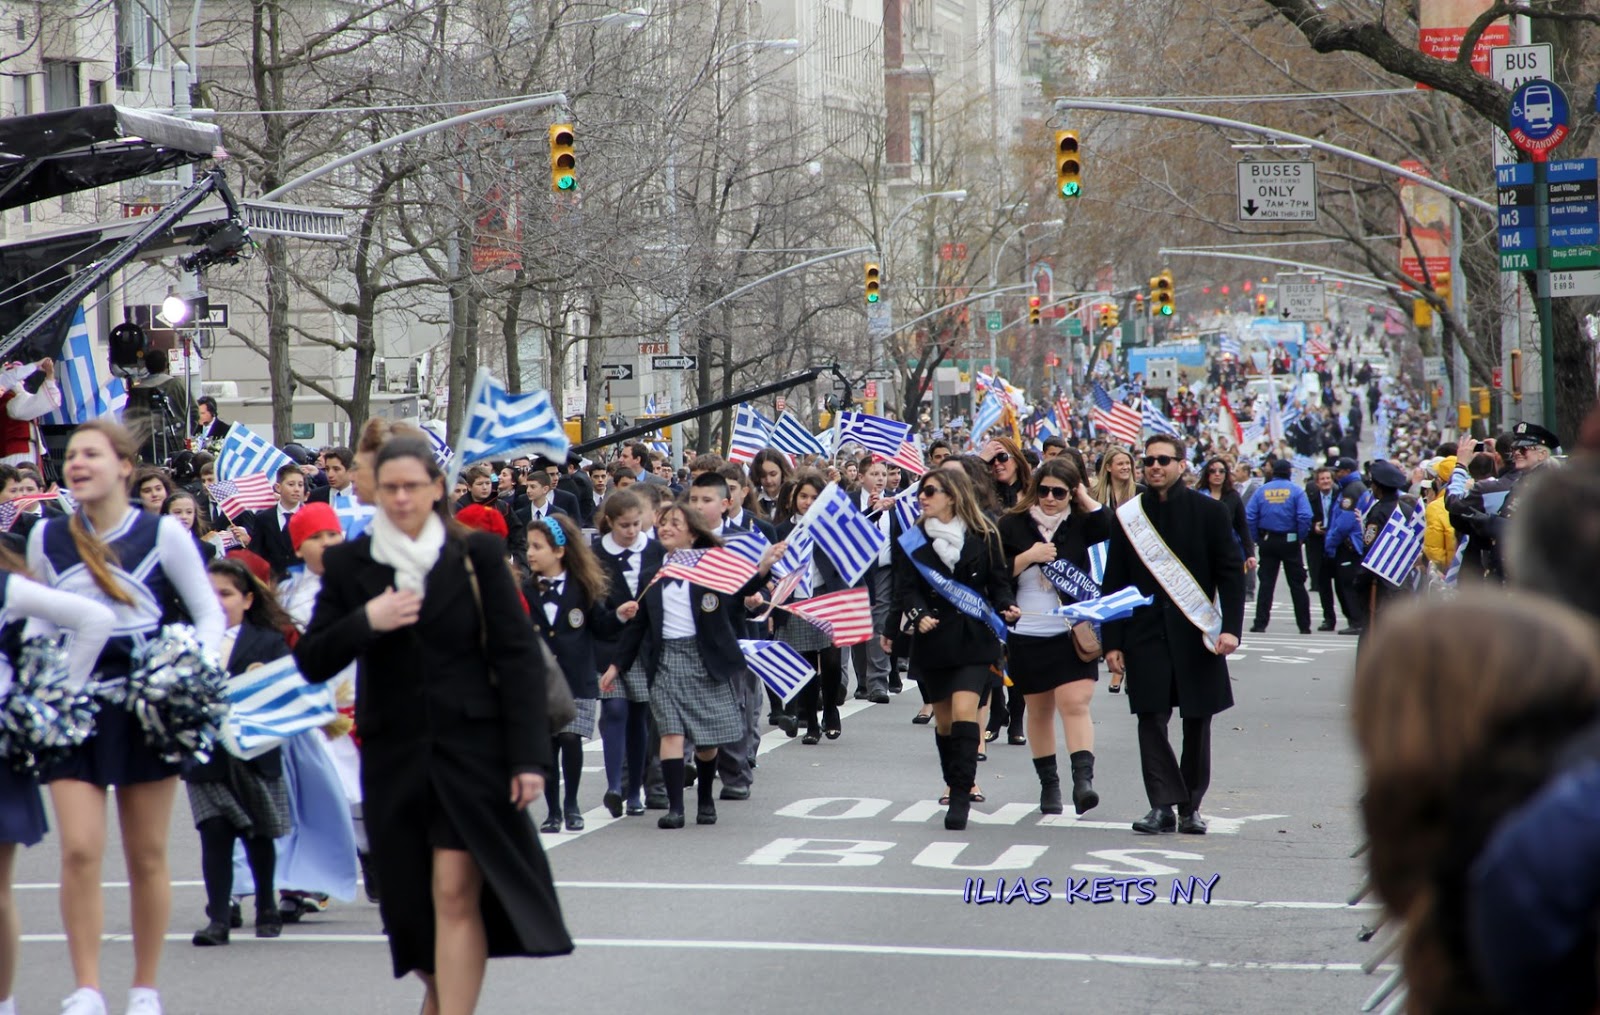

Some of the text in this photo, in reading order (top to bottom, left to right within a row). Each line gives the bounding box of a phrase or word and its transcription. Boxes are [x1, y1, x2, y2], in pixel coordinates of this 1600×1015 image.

[1432, 45, 1460, 54] Drawing
[1506, 52, 1537, 70] BUS
[1502, 75, 1542, 91] LA
[1514, 130, 1526, 143] NO
[1525, 129, 1563, 150] STANDING
[1251, 165, 1301, 177] BUSES
[1550, 162, 1585, 171] East Village
[1499, 166, 1516, 182] M1
[1258, 185, 1295, 197] ONLY
[1562, 183, 1580, 192] Village
[1500, 190, 1517, 206] M2
[1261, 210, 1278, 218] MON
[1300, 209, 1314, 218] FRI
[1552, 205, 1588, 214] East Village
[1501, 209, 1519, 226] M3
[1552, 227, 1593, 237] Penn Station
[1502, 231, 1521, 248] M4
[1553, 249, 1567, 258] Drop
[1568, 248, 1577, 257] Off
[1502, 254, 1529, 269] MTA
[1560, 273, 1567, 281] Av
[1554, 281, 1575, 290] E 69 St
[646, 345, 654, 353] 67
[658, 344, 665, 353] ST
[611, 368, 626, 376] WAY
[1042, 566, 1078, 596] ASTORIA
[1066, 567, 1100, 599] CATHEDR
[773, 797, 1291, 834] ONLY
[738, 838, 1205, 876] BUS
